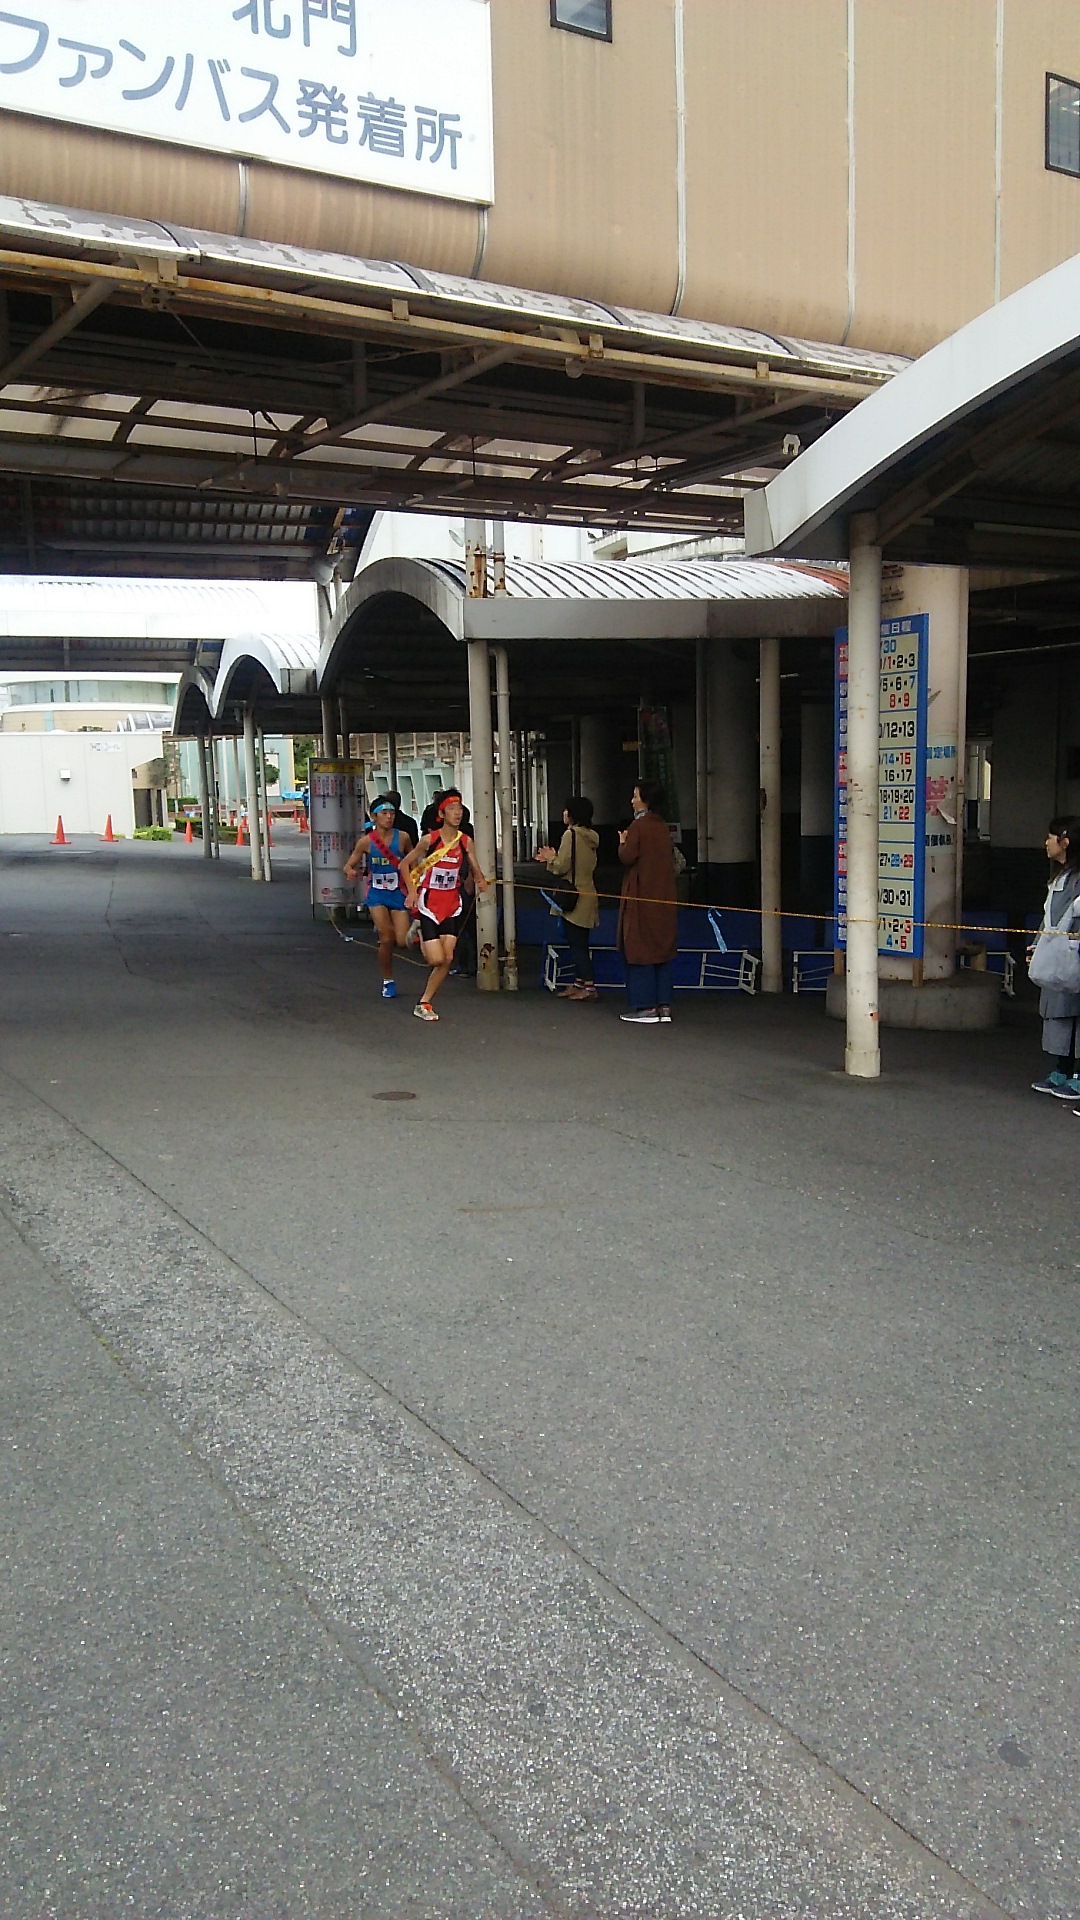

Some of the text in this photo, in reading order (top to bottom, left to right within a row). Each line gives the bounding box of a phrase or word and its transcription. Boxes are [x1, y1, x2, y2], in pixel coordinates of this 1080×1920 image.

[0, 11, 463, 169] ファンバス発着所
